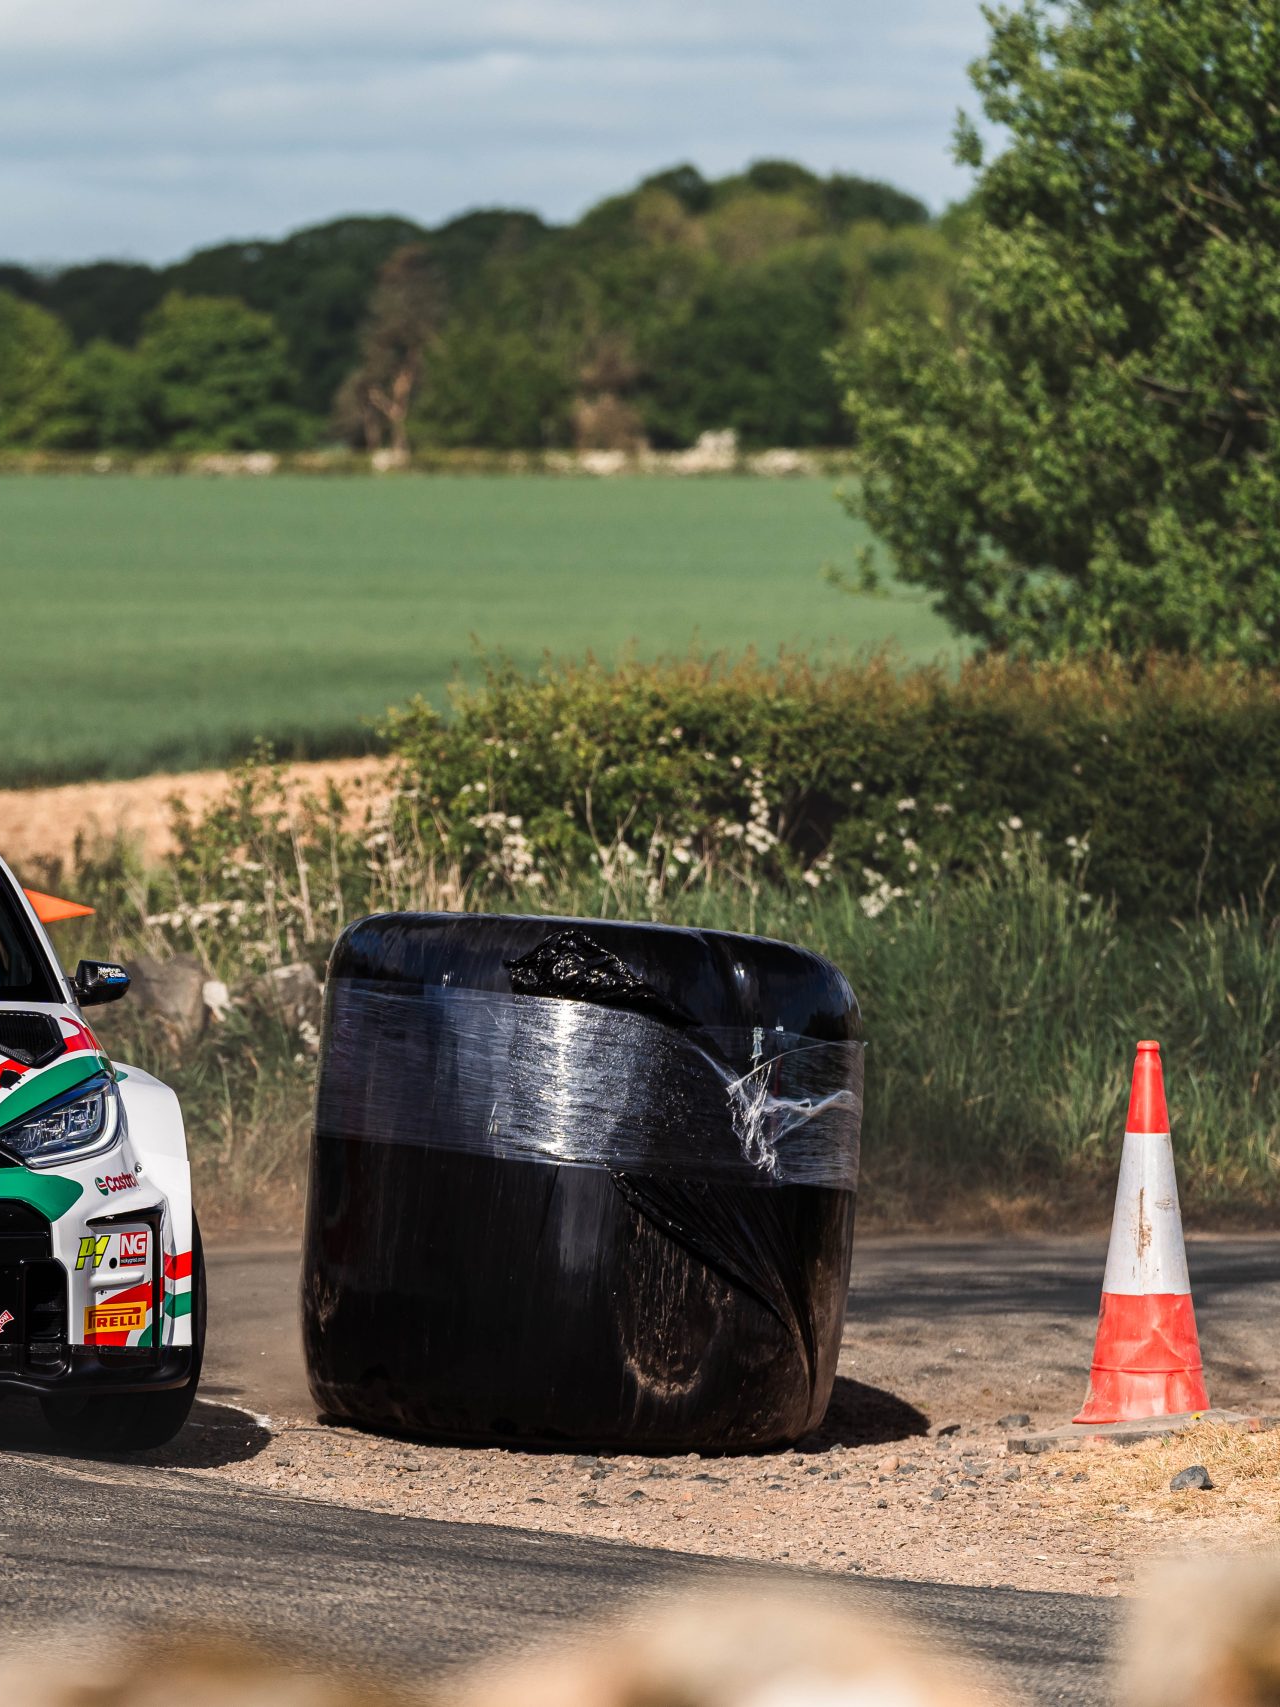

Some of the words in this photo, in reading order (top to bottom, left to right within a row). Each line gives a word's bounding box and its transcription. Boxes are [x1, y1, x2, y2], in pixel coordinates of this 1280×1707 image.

[105, 1171, 139, 1192] Castrol
[75, 1235, 111, 1270] P1
[120, 1233, 147, 1256] NG
[88, 1306, 142, 1330] PIRELLI
